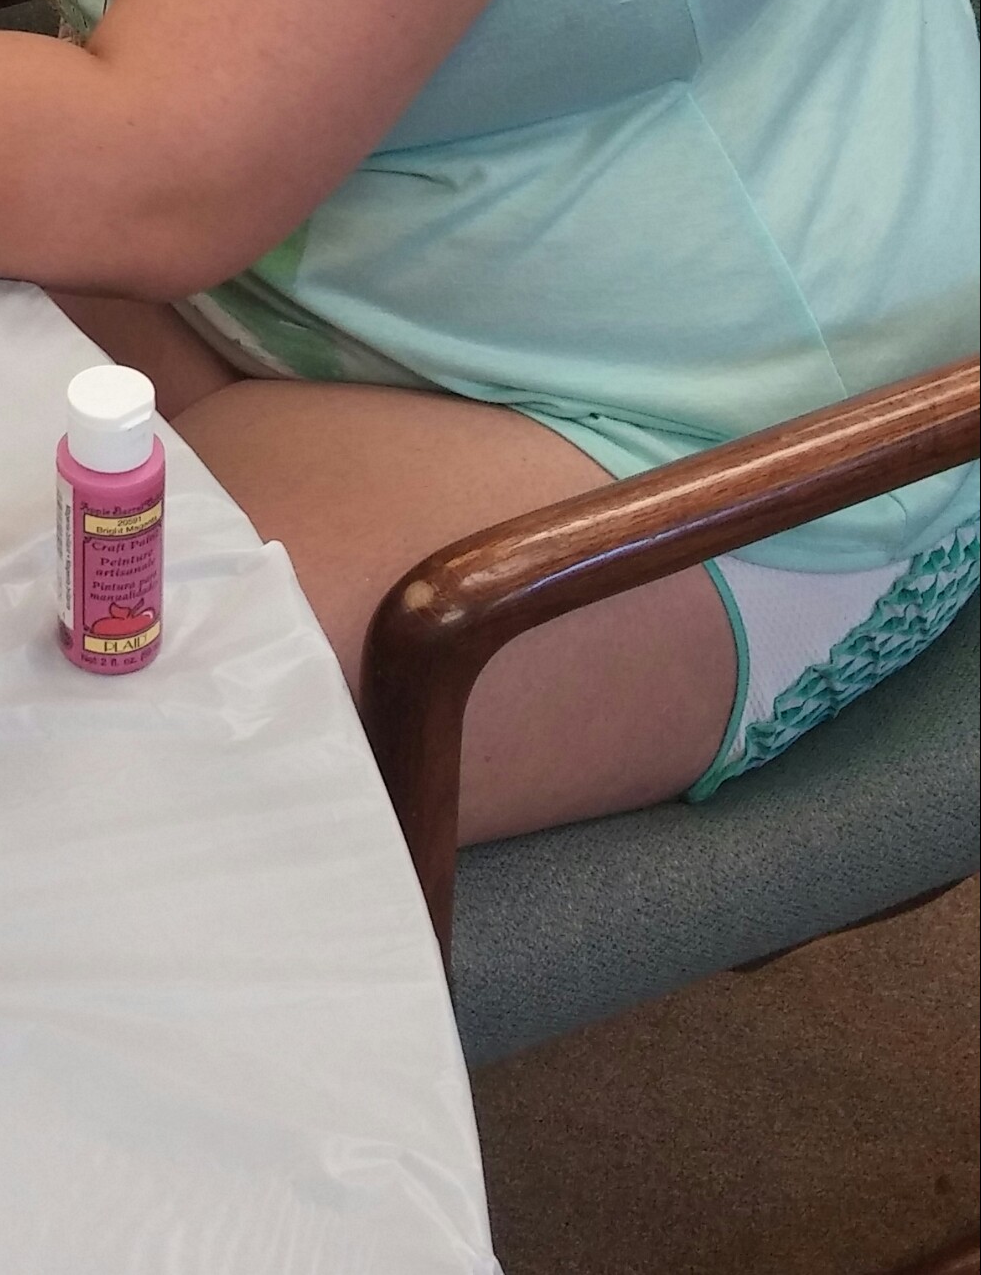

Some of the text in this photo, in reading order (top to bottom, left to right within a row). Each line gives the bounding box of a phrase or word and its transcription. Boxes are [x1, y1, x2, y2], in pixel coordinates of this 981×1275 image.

[96, 516, 158, 535] Bright Magenta
[92, 529, 160, 555] Craft Paint
[100, 549, 155, 567] Peinture
[96, 558, 156, 578] artisanale
[92, 580, 136, 592] Pintura
[104, 634, 147, 653] PLAID
